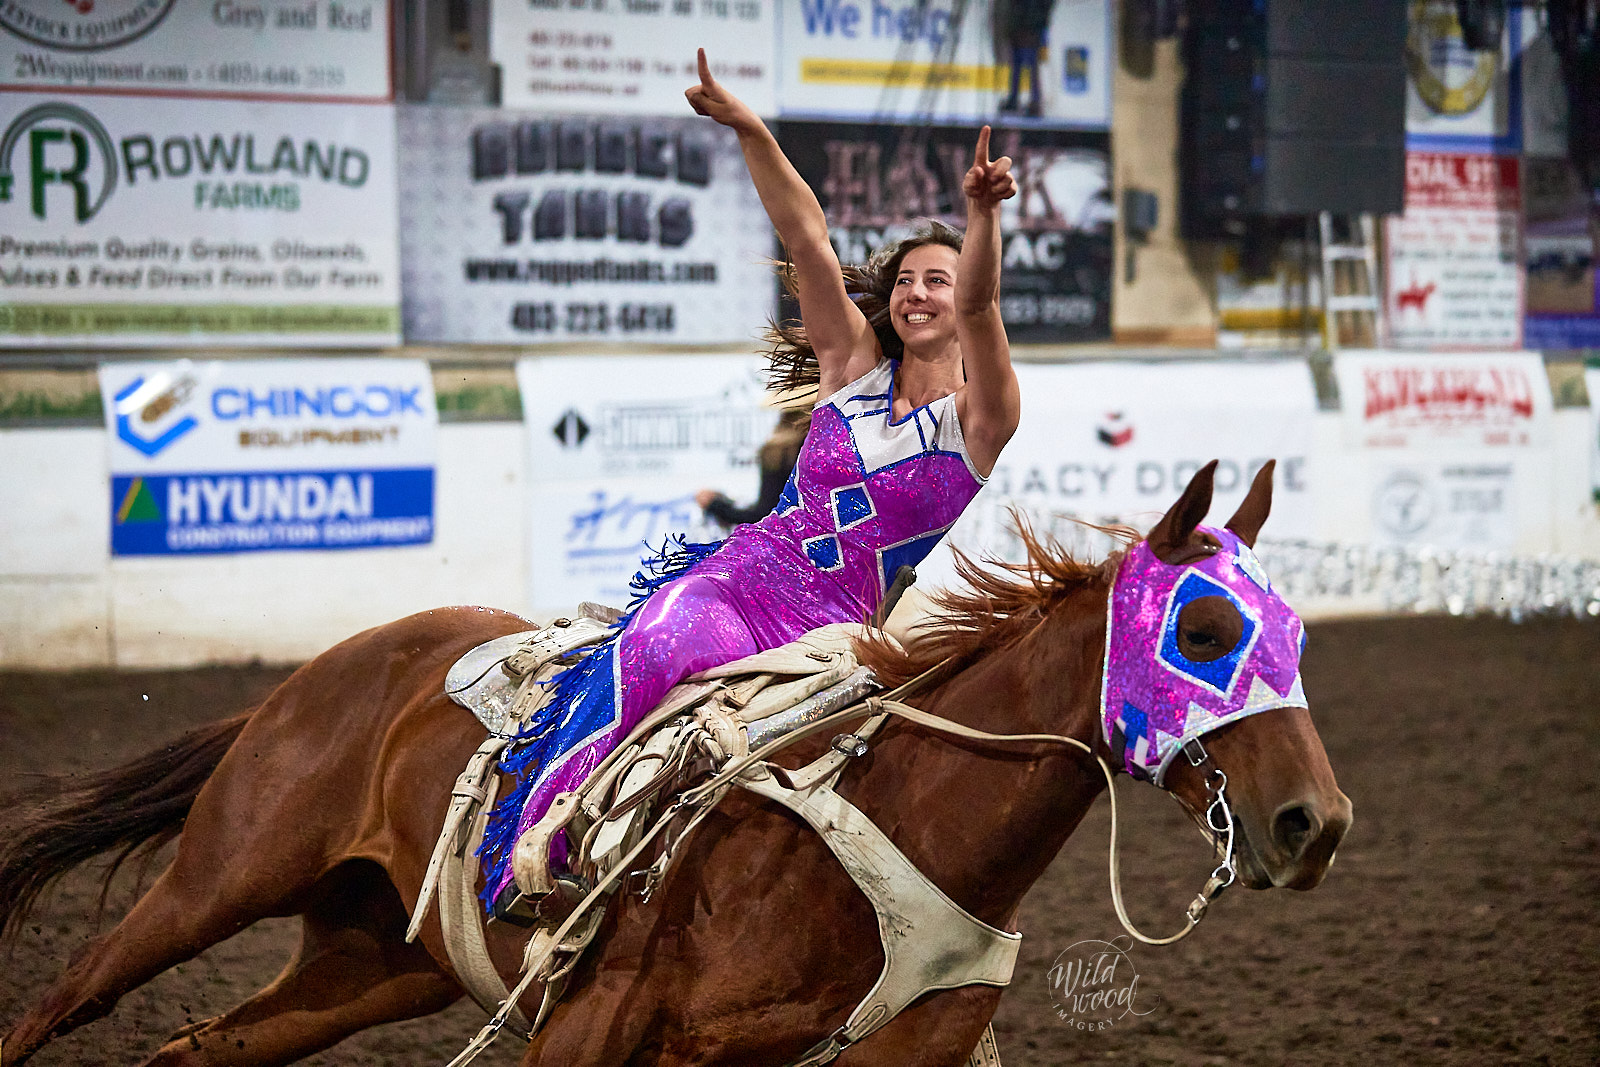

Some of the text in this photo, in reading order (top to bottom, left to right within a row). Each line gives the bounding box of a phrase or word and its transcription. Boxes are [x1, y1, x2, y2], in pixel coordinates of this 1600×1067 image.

[276, 2, 317, 30] and
[328, 2, 372, 32] Red
[798, 0, 862, 39] We
[120, 133, 371, 190] ROWLAND
[194, 181, 302, 212] FARMS
[493, 189, 695, 249] TANKS
[0, 234, 99, 258] Premium
[105, 236, 183, 263] Quality
[87, 265, 143, 289] Feed
[147, 265, 213, 290] Direct
[221, 266, 276, 290] From
[210, 384, 423, 420] CHINOOK
[239, 425, 399, 447] EQUIPMENT
[167, 474, 375, 522] HYUNDAI
